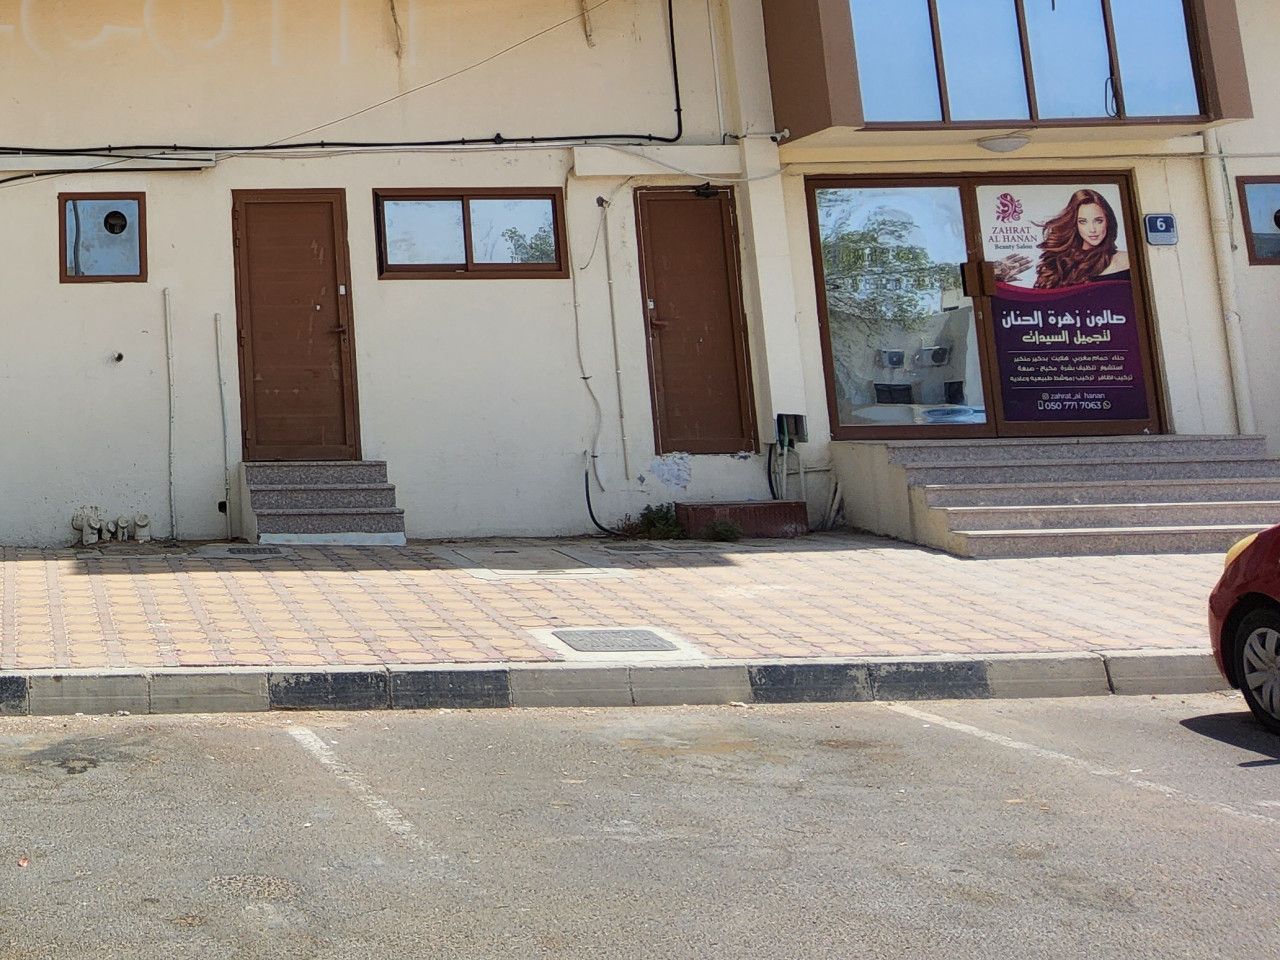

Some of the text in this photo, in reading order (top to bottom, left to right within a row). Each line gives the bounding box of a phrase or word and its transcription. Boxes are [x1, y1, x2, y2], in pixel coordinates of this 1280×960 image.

[1156, 218, 1166, 231] 6
[992, 226, 1031, 235] ZAHRAT
[988, 234, 1038, 243] AL HANAN
[994, 243, 1015, 251] Beauty
[1001, 309, 1126, 329] صالون زهرة الحنان
[1022, 330, 1069, 345] السيدات
[1045, 401, 1062, 410] 050
[1079, 401, 1102, 410] 7063
